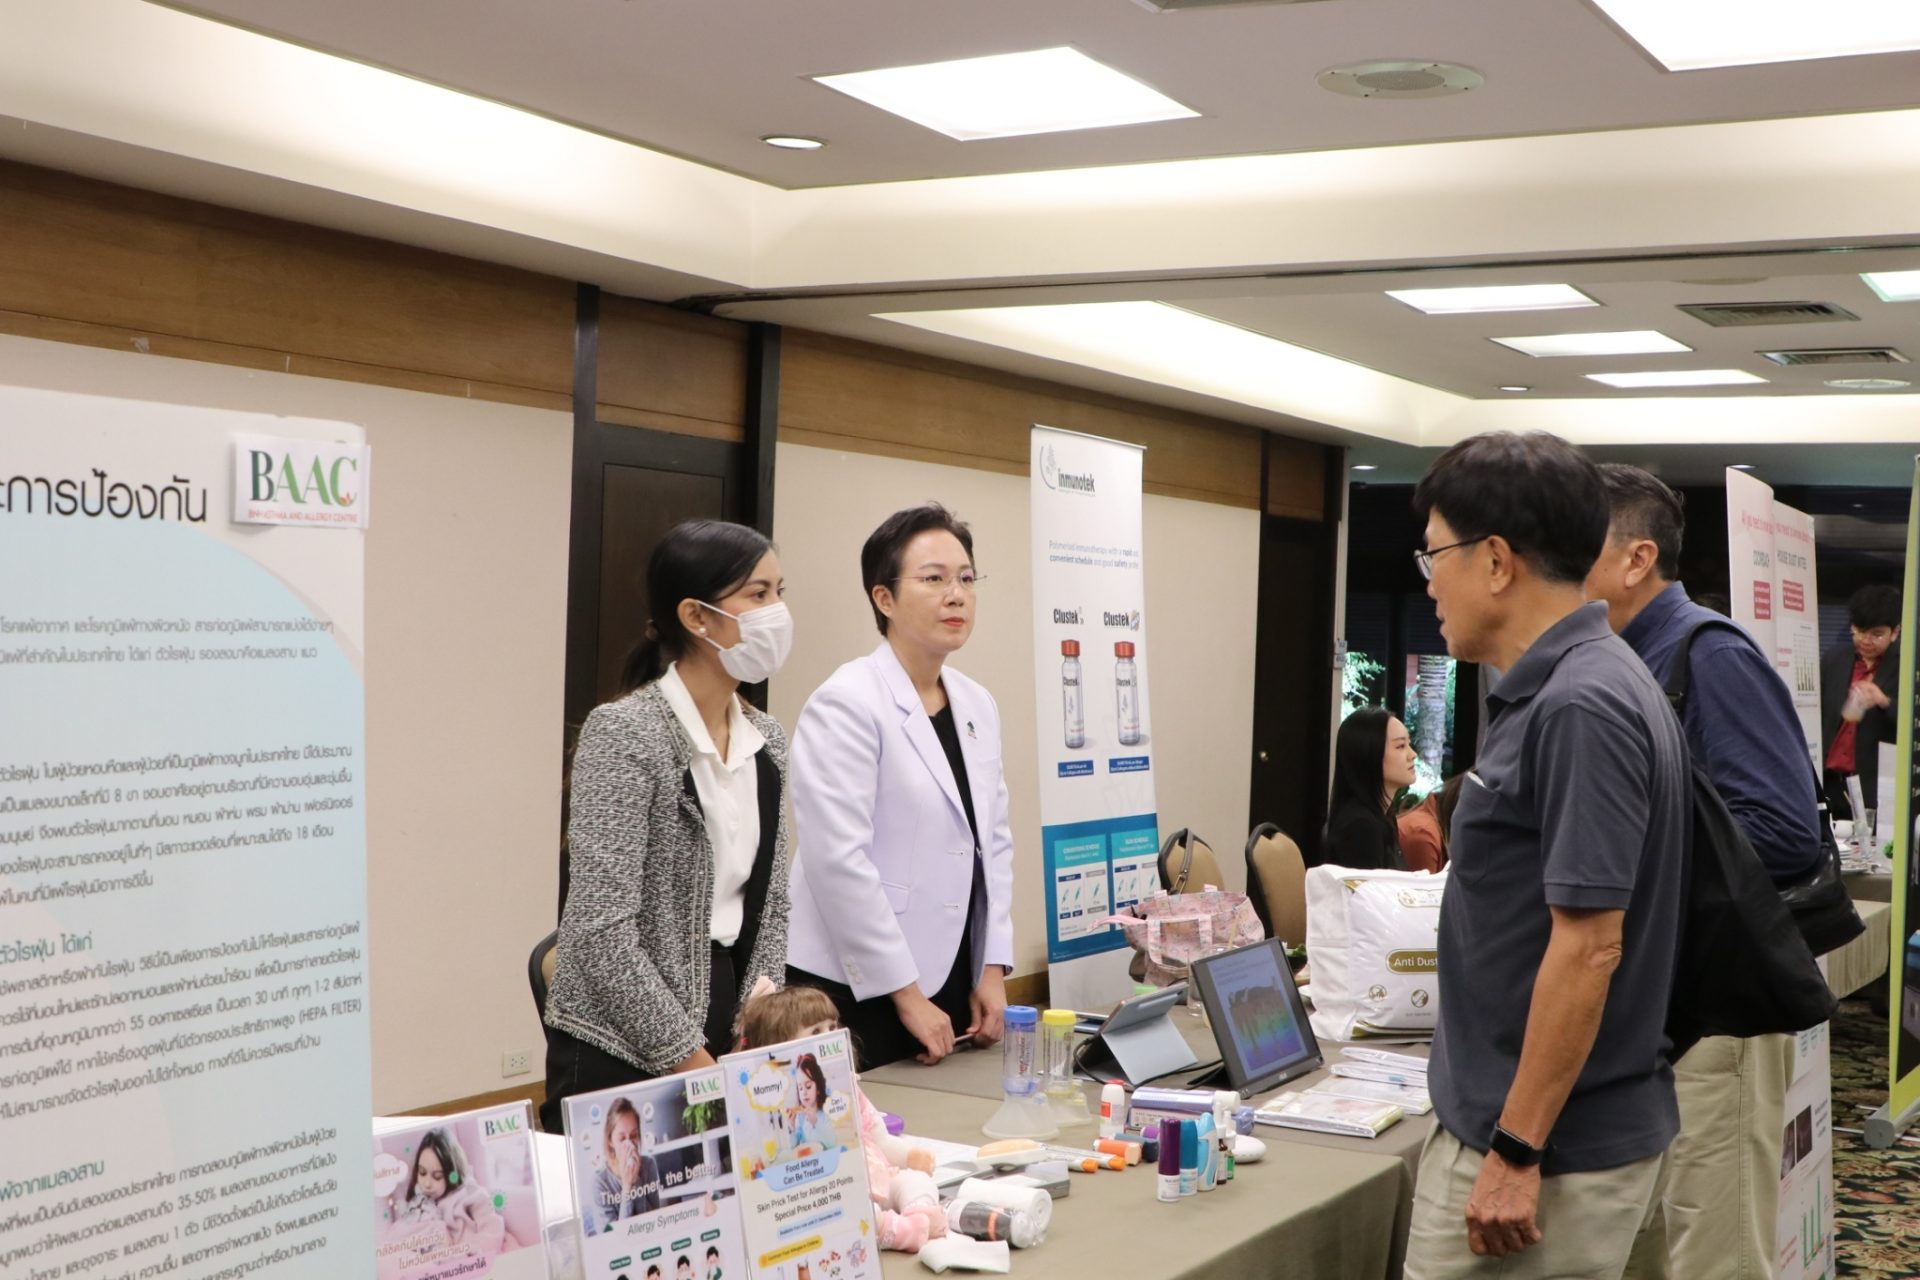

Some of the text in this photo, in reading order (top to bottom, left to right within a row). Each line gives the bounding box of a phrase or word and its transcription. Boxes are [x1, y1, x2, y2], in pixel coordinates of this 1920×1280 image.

[249, 449, 357, 507] BAAC
[0, 468, 206, 522] การป้องกัน
[1053, 608, 1079, 624] Clustek
[1104, 611, 1130, 626] Clustek
[115, 788, 122, 802] 8
[297, 826, 308, 839] 18
[60, 931, 93, 954] ได้แก่
[1394, 957, 1414, 967] Anti
[130, 1014, 144, 1031] 55
[255, 990, 268, 1006] 30
[315, 978, 330, 993] 1-2
[299, 1009, 328, 1025] (HEPA
[331, 998, 362, 1017] FILTER)
[753, 1081, 783, 1096] Mommy!
[783, 1176, 795, 1185] Can
[803, 1166, 824, 1178] Treated
[785, 1158, 819, 1174] Food Allergy
[600, 1162, 717, 1206] The sooner, the better
[757, 1203, 771, 1213] Skin
[771, 1198, 786, 1208] Prick
[786, 1193, 799, 1203] Test
[799, 1190, 808, 1200] for
[809, 1185, 828, 1196] Allergy
[836, 1176, 854, 1187] Points
[628, 1207, 700, 1235] Allergy Symptoms
[774, 1207, 796, 1221] Special
[797, 1203, 812, 1214] Price
